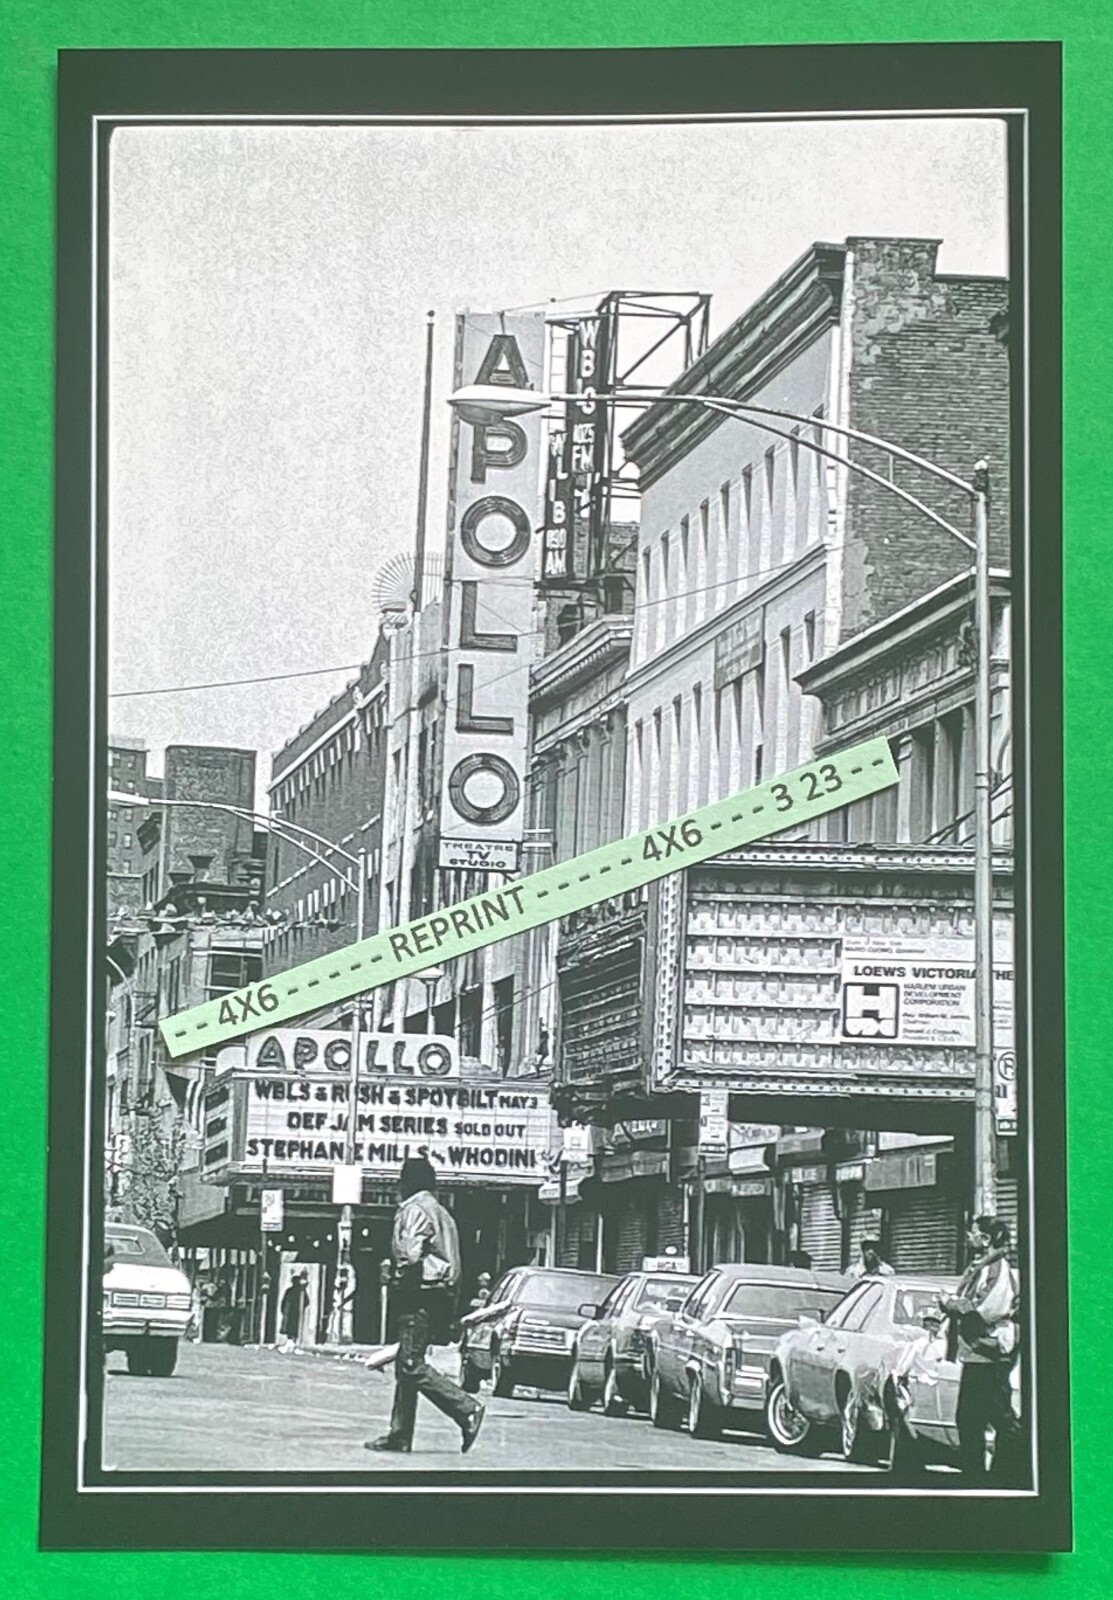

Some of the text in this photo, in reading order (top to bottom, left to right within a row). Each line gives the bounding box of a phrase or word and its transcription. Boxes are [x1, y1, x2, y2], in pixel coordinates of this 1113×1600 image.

[449, 334, 533, 827] APOLLO
[449, 858, 507, 868] STUDIO
[467, 850, 491, 860] TV
[218, 763, 844, 1026] 4X6 REPRINT 4X6 3 23
[854, 965, 907, 978] LOEWS
[256, 1035, 453, 1077] APOLLO
[254, 1080, 311, 1102] WBLS
[287, 1111, 328, 1131] DEF
[379, 1115, 448, 1137] SERIES
[454, 1121, 491, 1137] SOLD
[494, 1124, 527, 1139] OUT
[246, 1139, 364, 1161] STEPHANE
[448, 1146, 537, 1169] WHODINI
